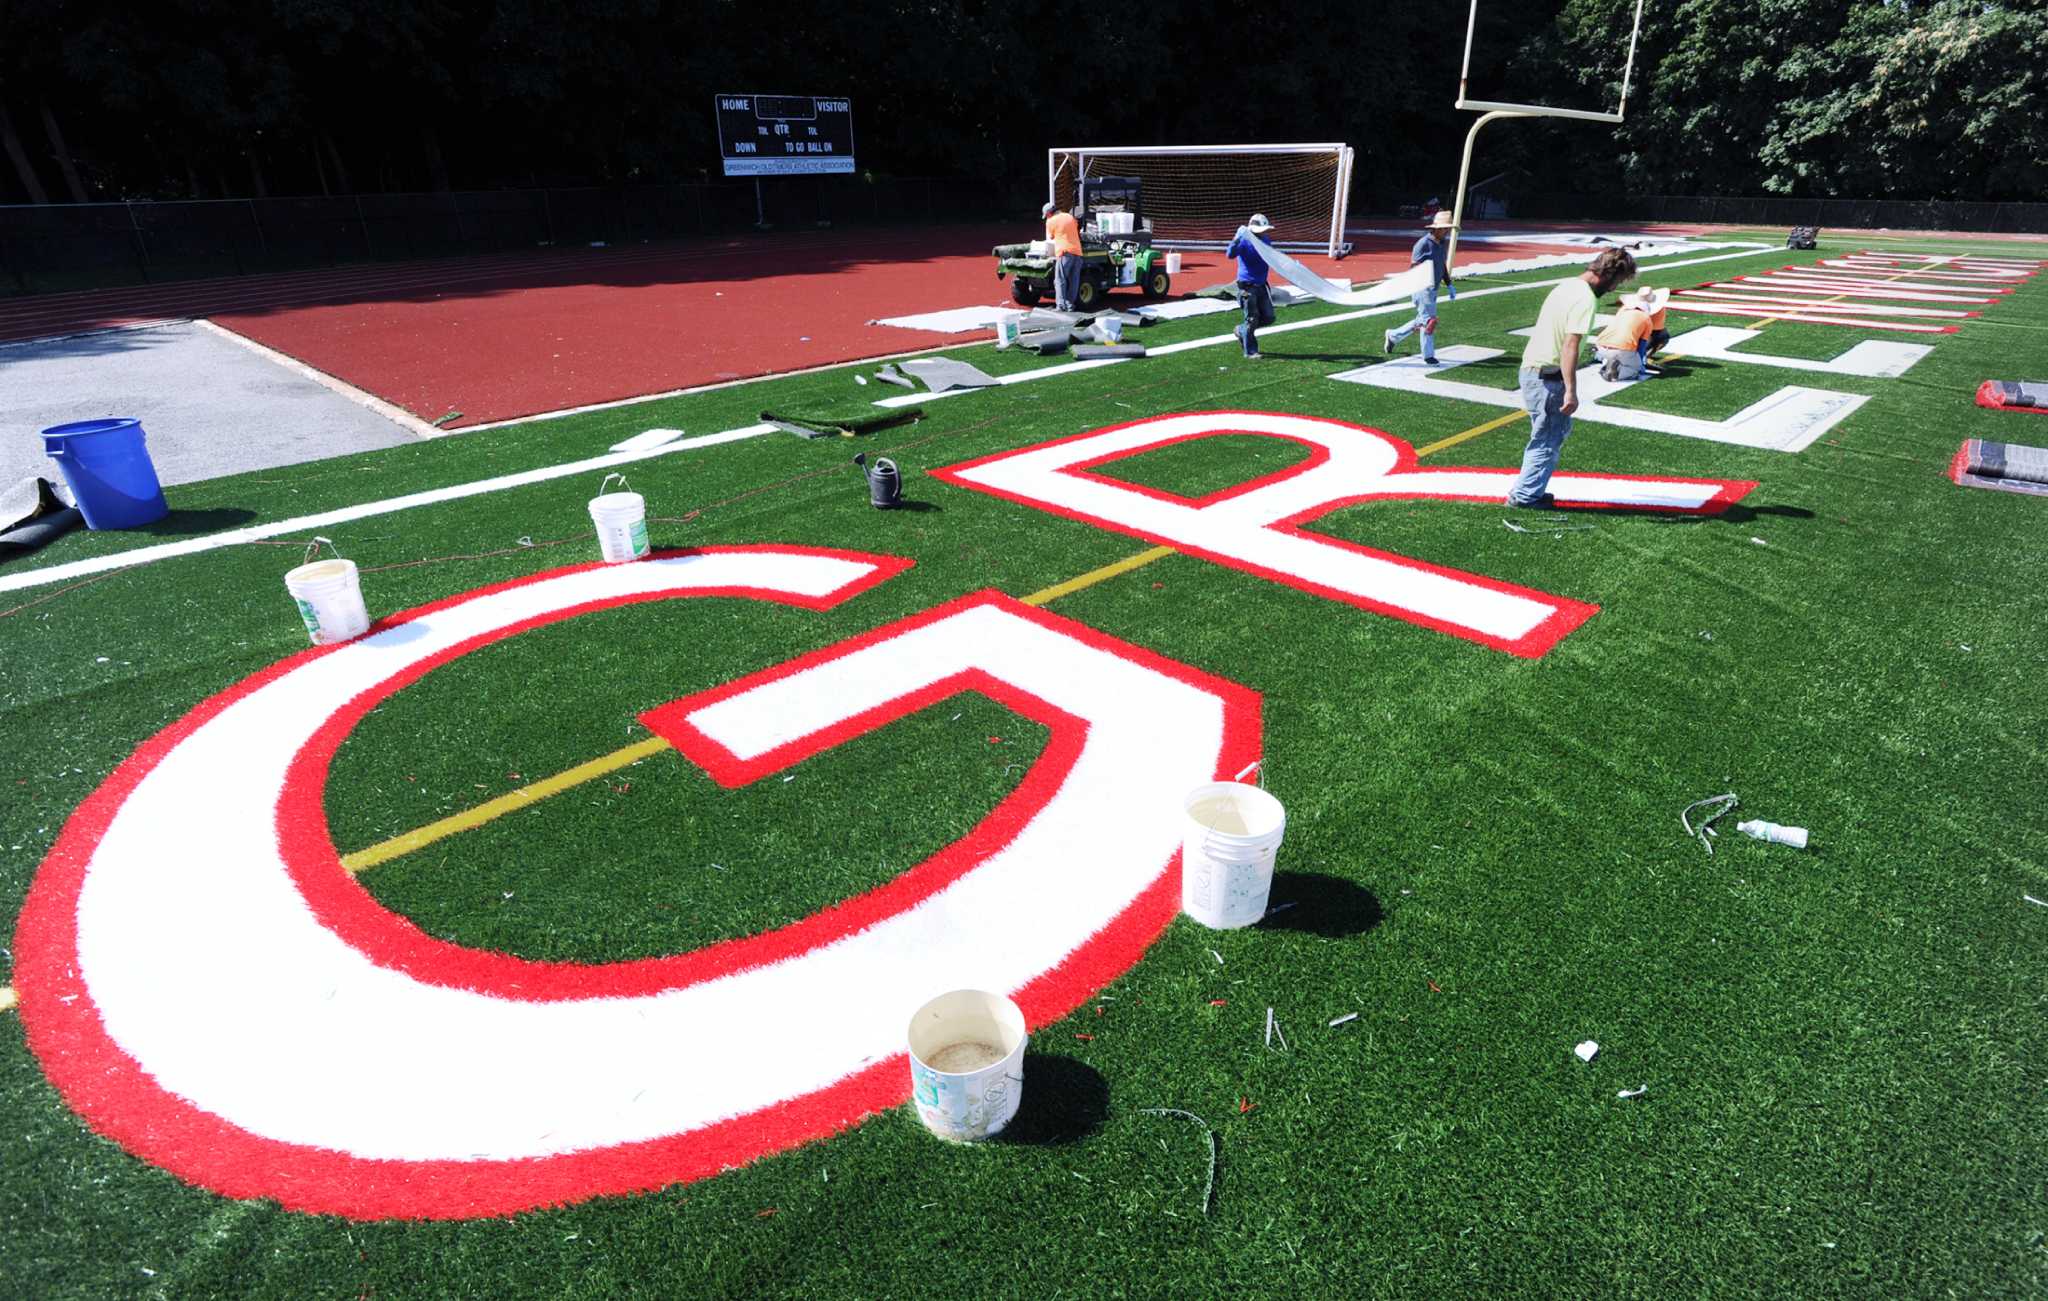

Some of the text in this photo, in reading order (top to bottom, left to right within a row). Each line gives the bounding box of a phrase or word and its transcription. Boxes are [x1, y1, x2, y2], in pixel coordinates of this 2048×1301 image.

[722, 99, 750, 110] HOME
[816, 101, 849, 112] VISITOR
[774, 124, 790, 136] QTR
[735, 142, 756, 153] DOWN
[785, 142, 805, 153] TO GO
[807, 142, 833, 153] BALL ON
